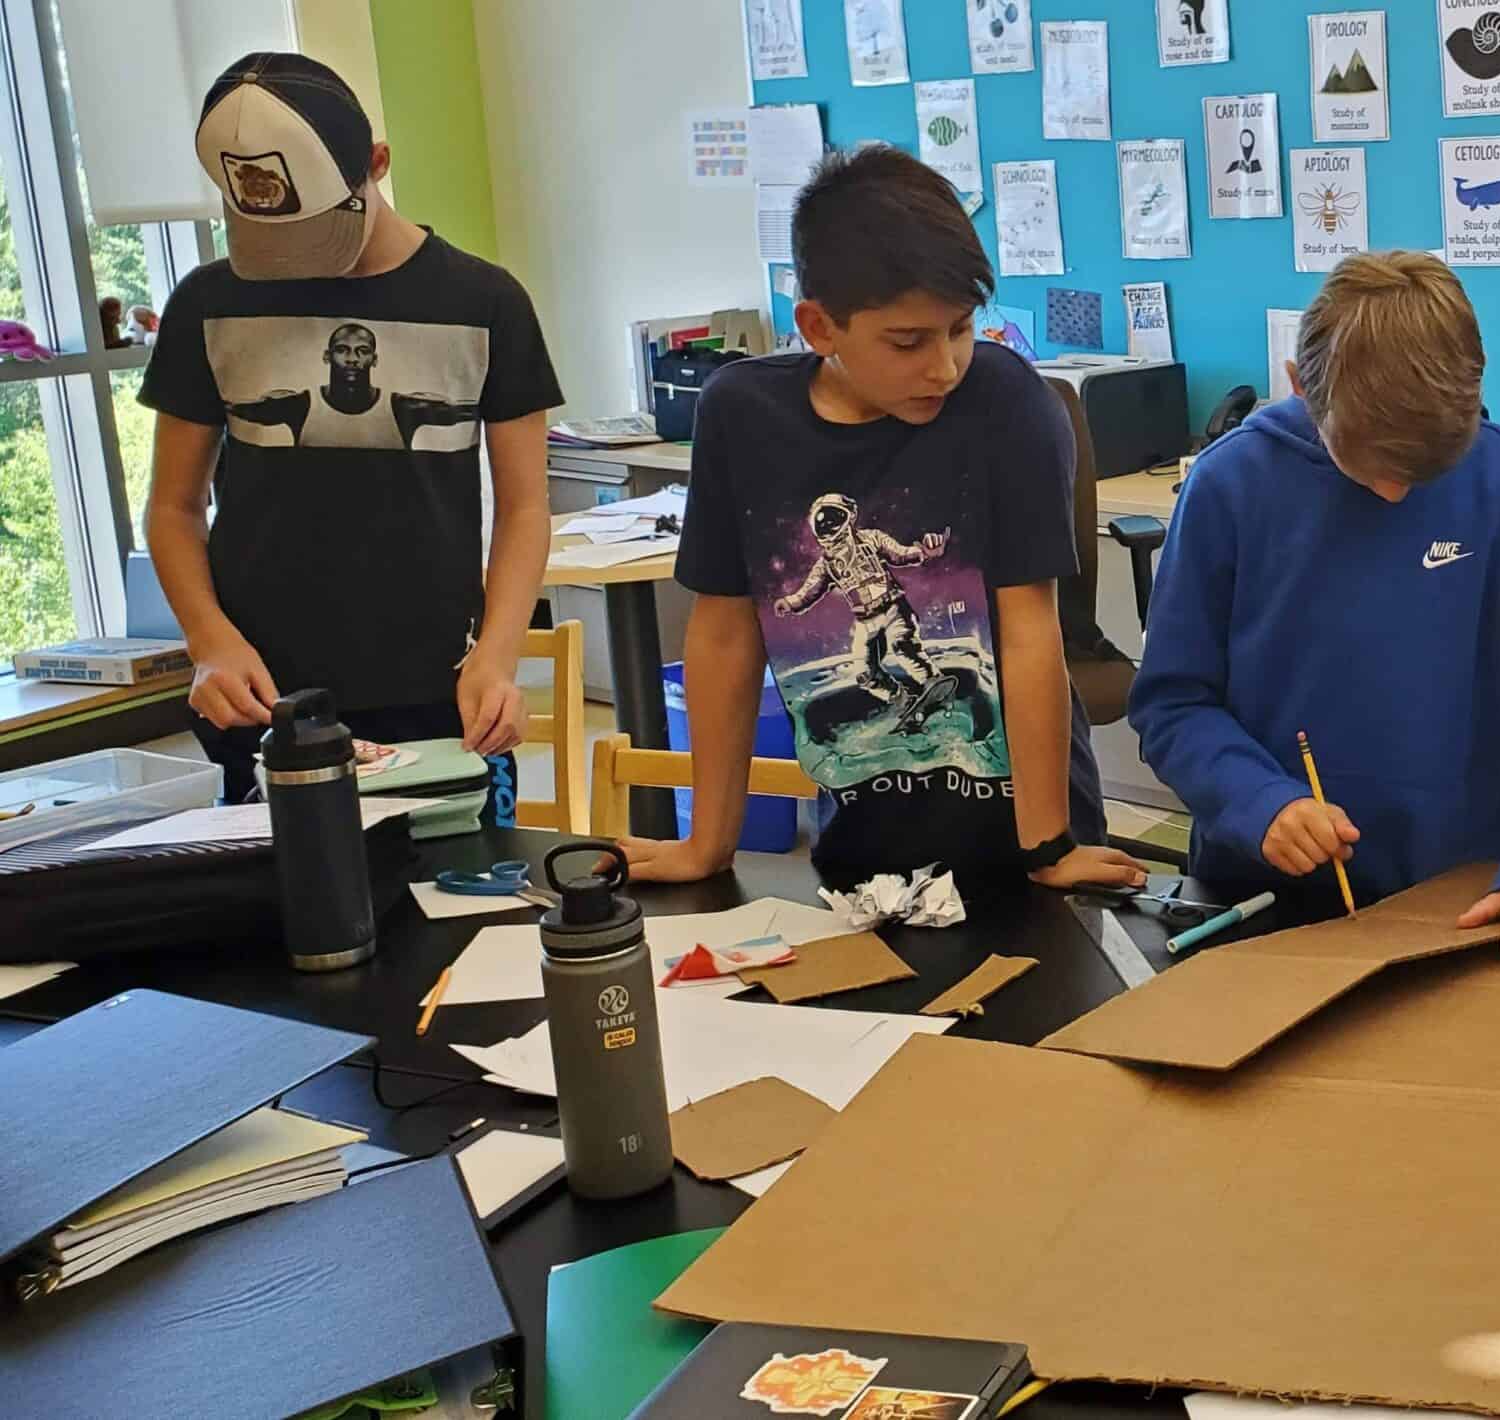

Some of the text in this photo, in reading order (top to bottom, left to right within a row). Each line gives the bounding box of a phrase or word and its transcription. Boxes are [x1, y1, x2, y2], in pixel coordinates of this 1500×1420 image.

[1325, 20, 1368, 38] OROLOGY
[1168, 36, 1191, 48] Study
[1193, 35, 1203, 45] of
[1185, 49, 1200, 59] and
[1462, 83, 1489, 96] Study
[1453, 98, 1487, 111] mollusk
[1331, 107, 1366, 120] Study of
[1121, 148, 1180, 163] MYRMECOLOGY
[1304, 156, 1351, 172] APIOLOGY
[1217, 187, 1241, 200] Study
[1463, 219, 1489, 232] Study
[1303, 243, 1327, 255] Study
[1329, 243, 1338, 253] of
[1454, 249, 1470, 258] and
[1430, 541, 1461, 558] NIKE
[872, 774, 934, 793] OUT
[947, 770, 1015, 799] DUDE
[595, 1012, 636, 1030] TAKEYA
[618, 1135, 638, 1155] 18
